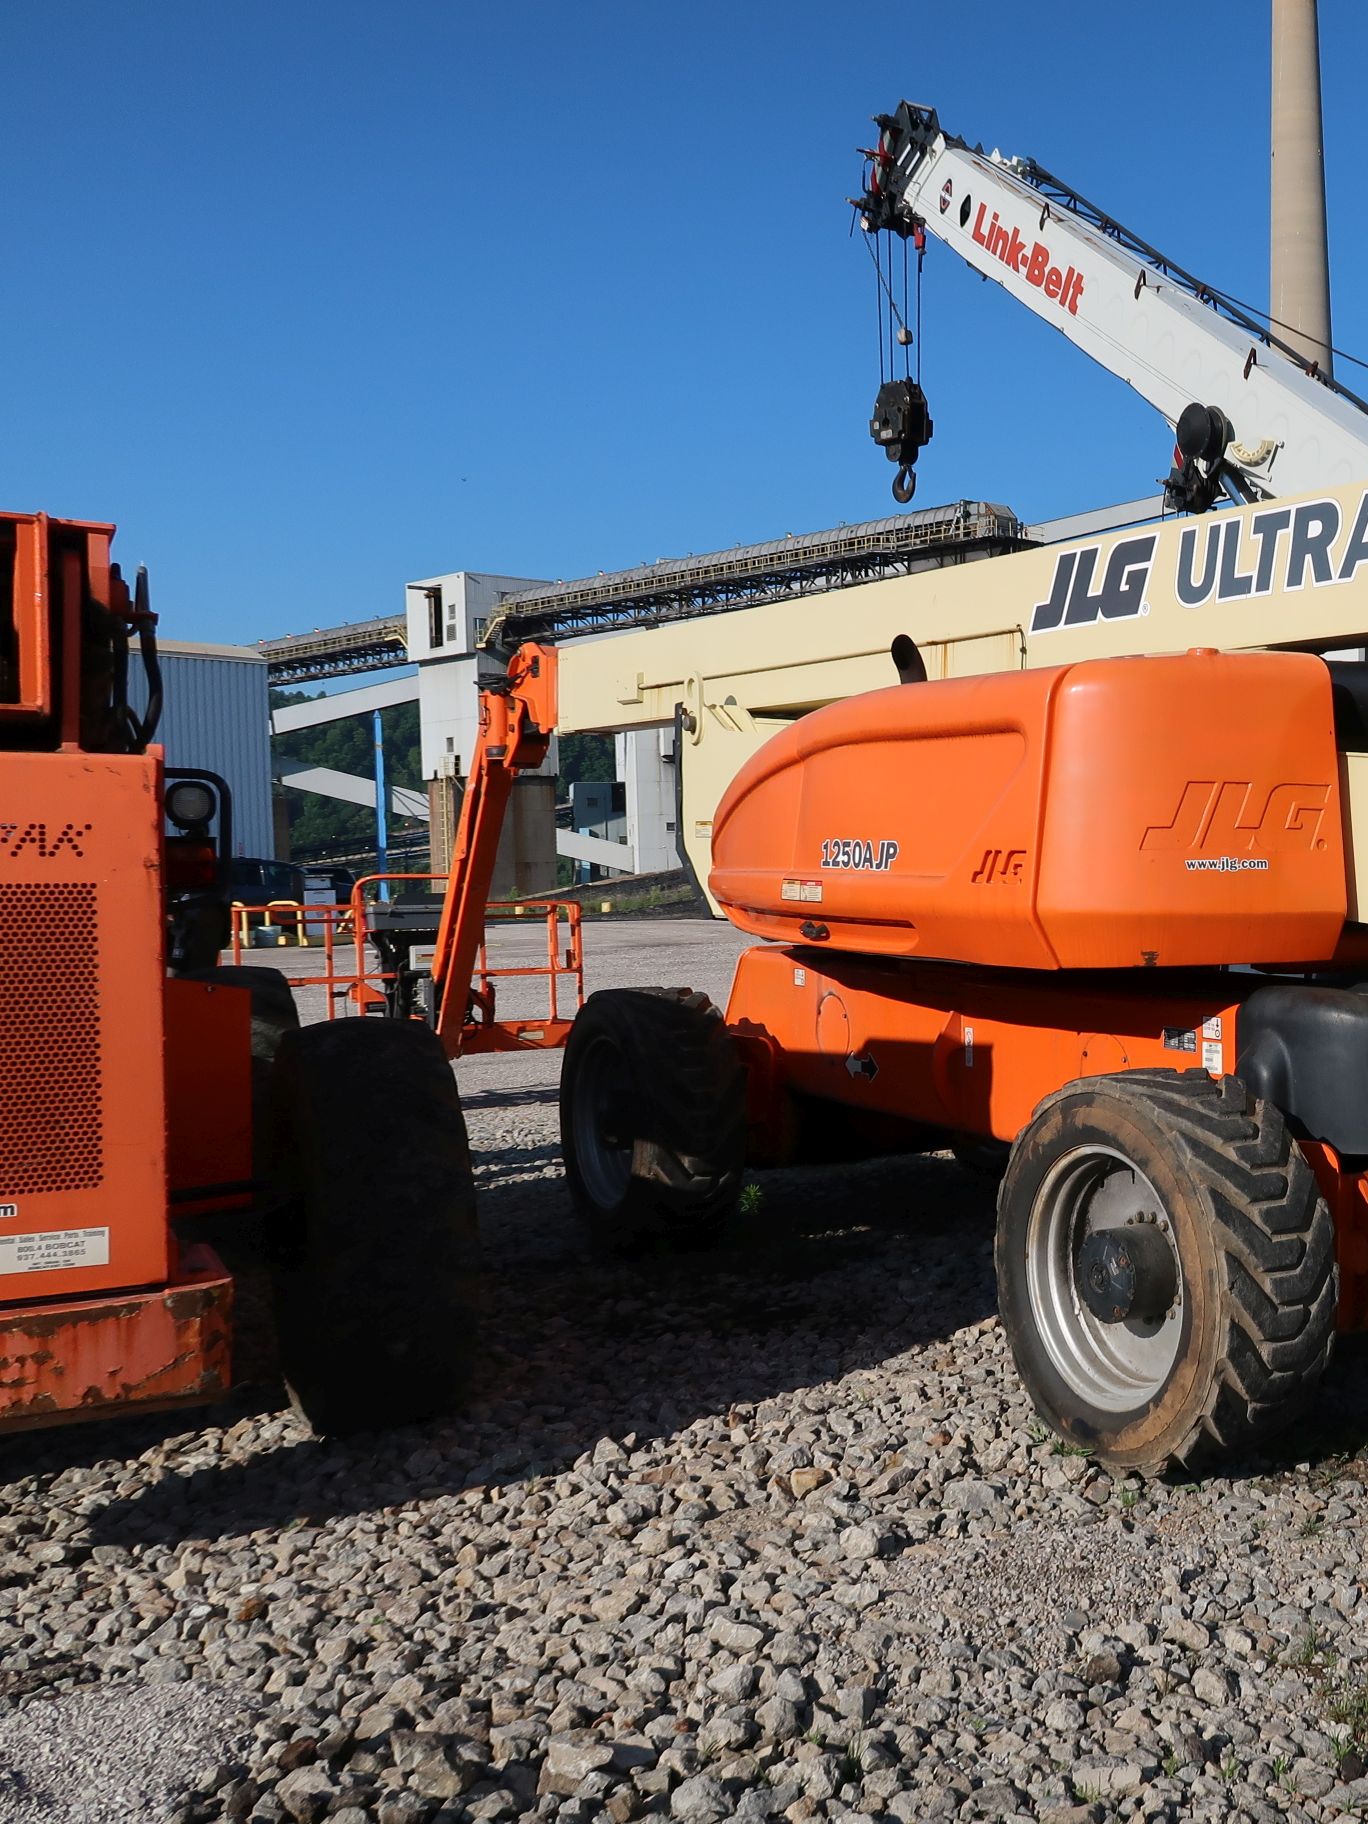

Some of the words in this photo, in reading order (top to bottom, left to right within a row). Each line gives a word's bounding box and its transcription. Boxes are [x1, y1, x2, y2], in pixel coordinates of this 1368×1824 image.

[971, 201, 1085, 316] Link-Belt
[1030, 533, 1158, 632] JLG
[1139, 781, 1332, 851] JLG
[821, 839, 899, 871] 1250AJP
[971, 849, 1027, 884] JLG
[1185, 857, 1268, 870] www.jlg.com
[45, 1240, 85, 1250] BOBCAT
